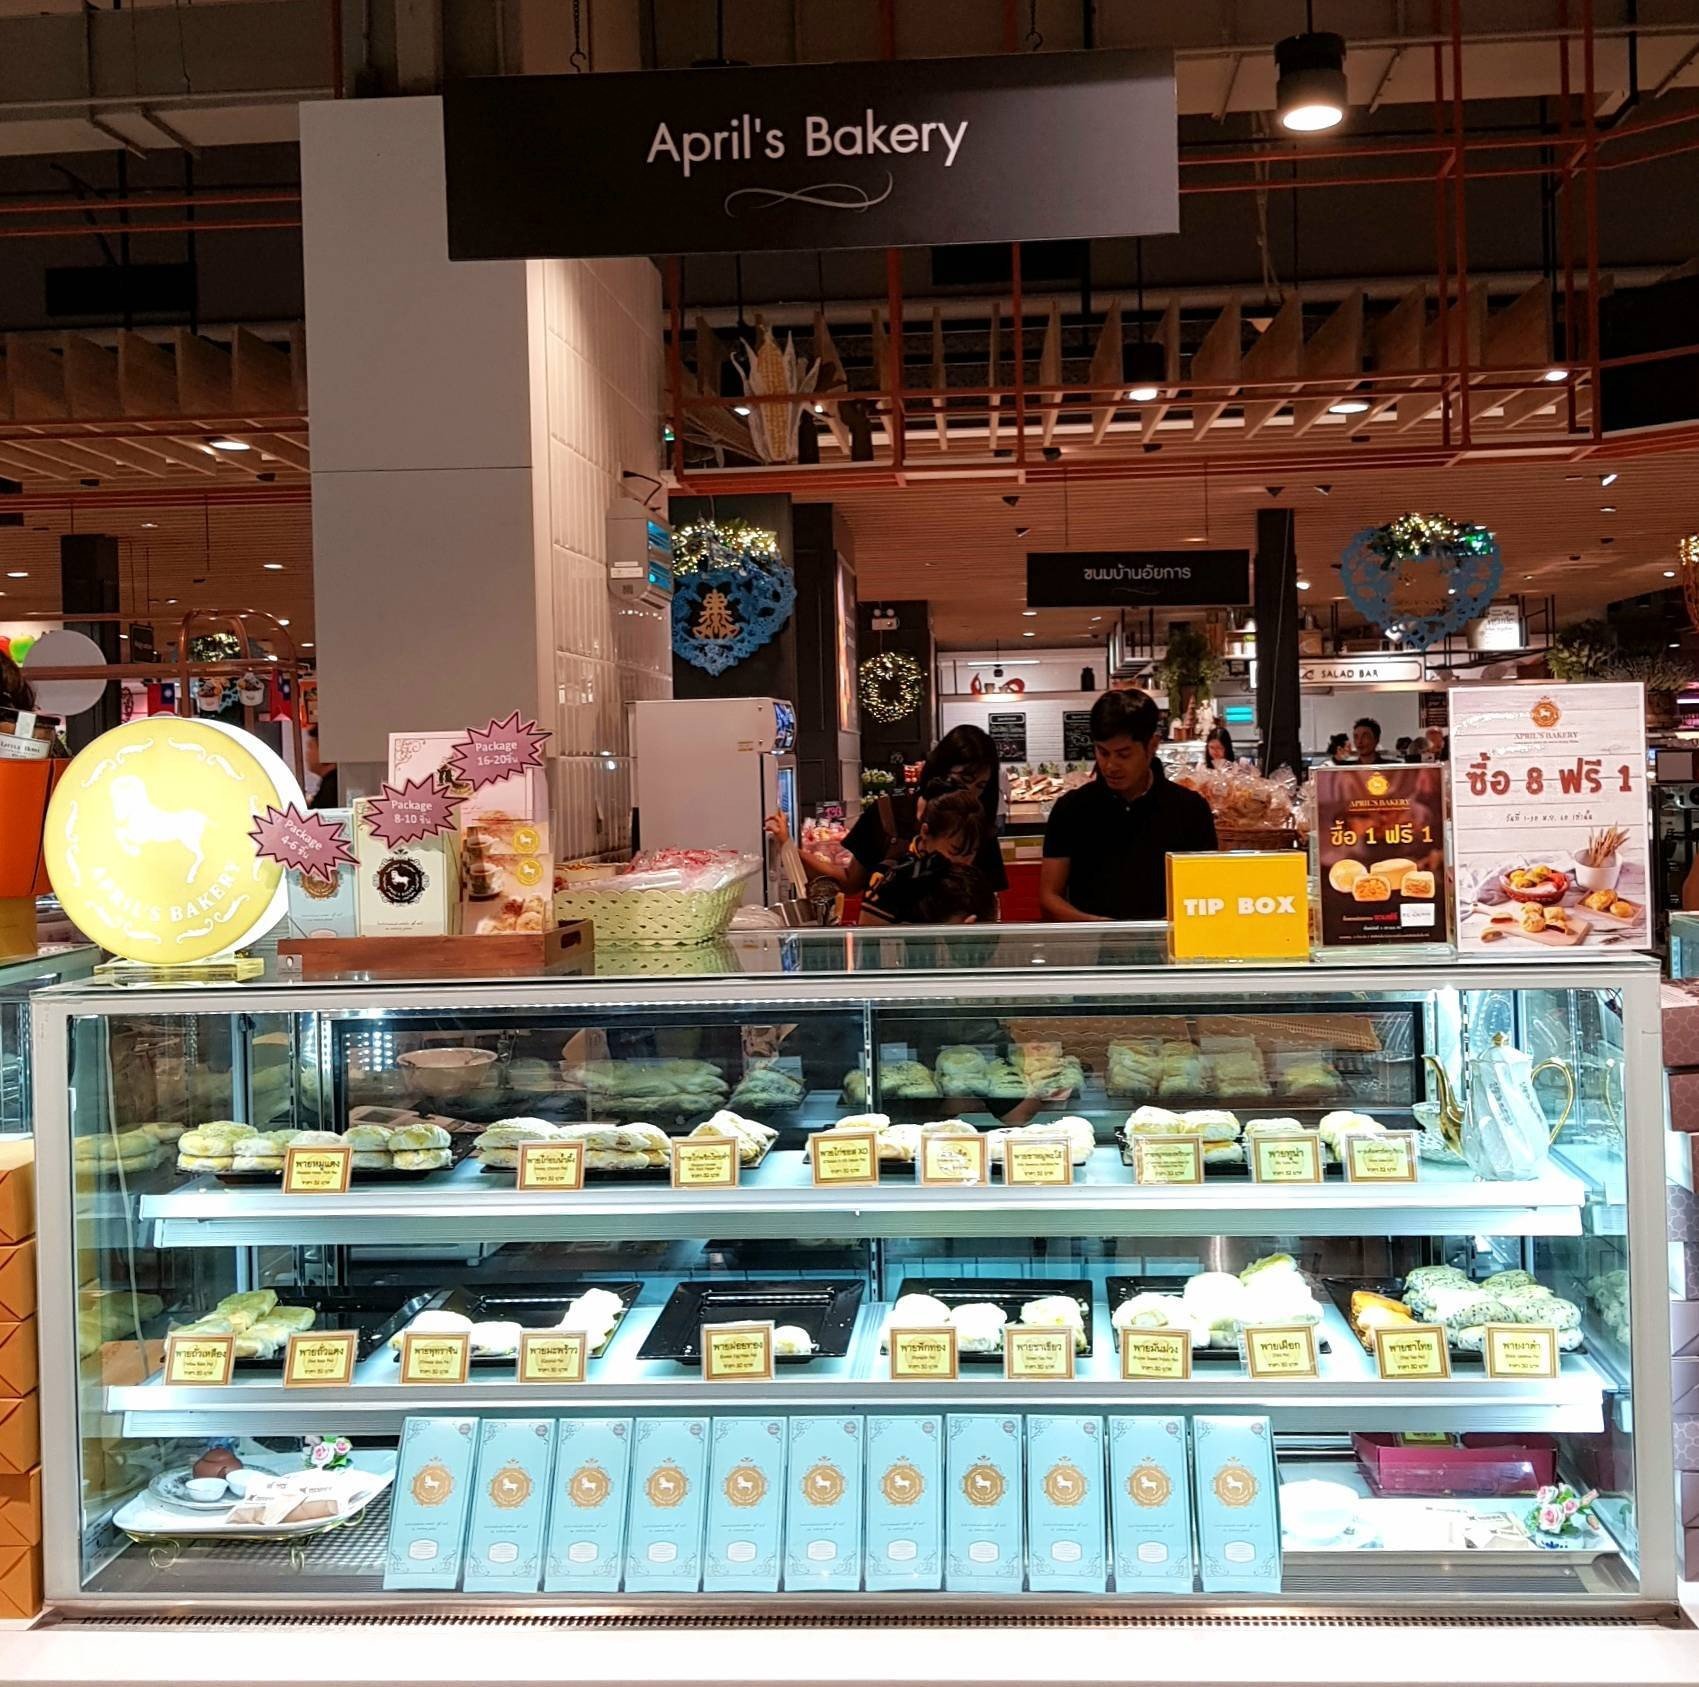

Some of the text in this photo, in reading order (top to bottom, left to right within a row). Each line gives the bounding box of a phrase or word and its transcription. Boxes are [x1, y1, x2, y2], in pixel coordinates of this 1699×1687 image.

[646, 108, 969, 178] April's Bakery
[1083, 563, 1192, 580] ขนมบ้านอัยการ
[1321, 669, 1379, 679] SALAD BAR
[1546, 731, 1579, 739] BAKERY
[475, 741, 518, 752] Package
[1466, 752, 1632, 796] ซื้อ 8 ฟรี 1
[391, 800, 433, 812] Package
[394, 814, 417, 824] 8-10
[284, 819, 322, 851] Package
[1330, 820, 1433, 845] ซื้อ 1 ฟรี 1
[170, 860, 240, 922] BAKERY
[1183, 896, 1296, 916] TIP BOX
[1268, 1147, 1304, 1160] พายทูน่า
[295, 1160, 341, 1171] พายหมูแดง
[299, 1343, 344, 1357] พายถั่วแดง
[530, 1344, 578, 1355] พายมะพร้าว
[713, 1341, 763, 1351] พายฝอยทอง
[1016, 1341, 1062, 1352] พายชาเขียว
[1133, 1342, 1179, 1354] พายมันม่วง
[1260, 1339, 1301, 1351] พายเผือก
[1388, 1339, 1433, 1352] พายชาไทย
[1502, 1339, 1541, 1351] พายงาดำ
[175, 1345, 227, 1358] พายถั่วเหลือง
[414, 1346, 458, 1358] พายพุทราจีน
